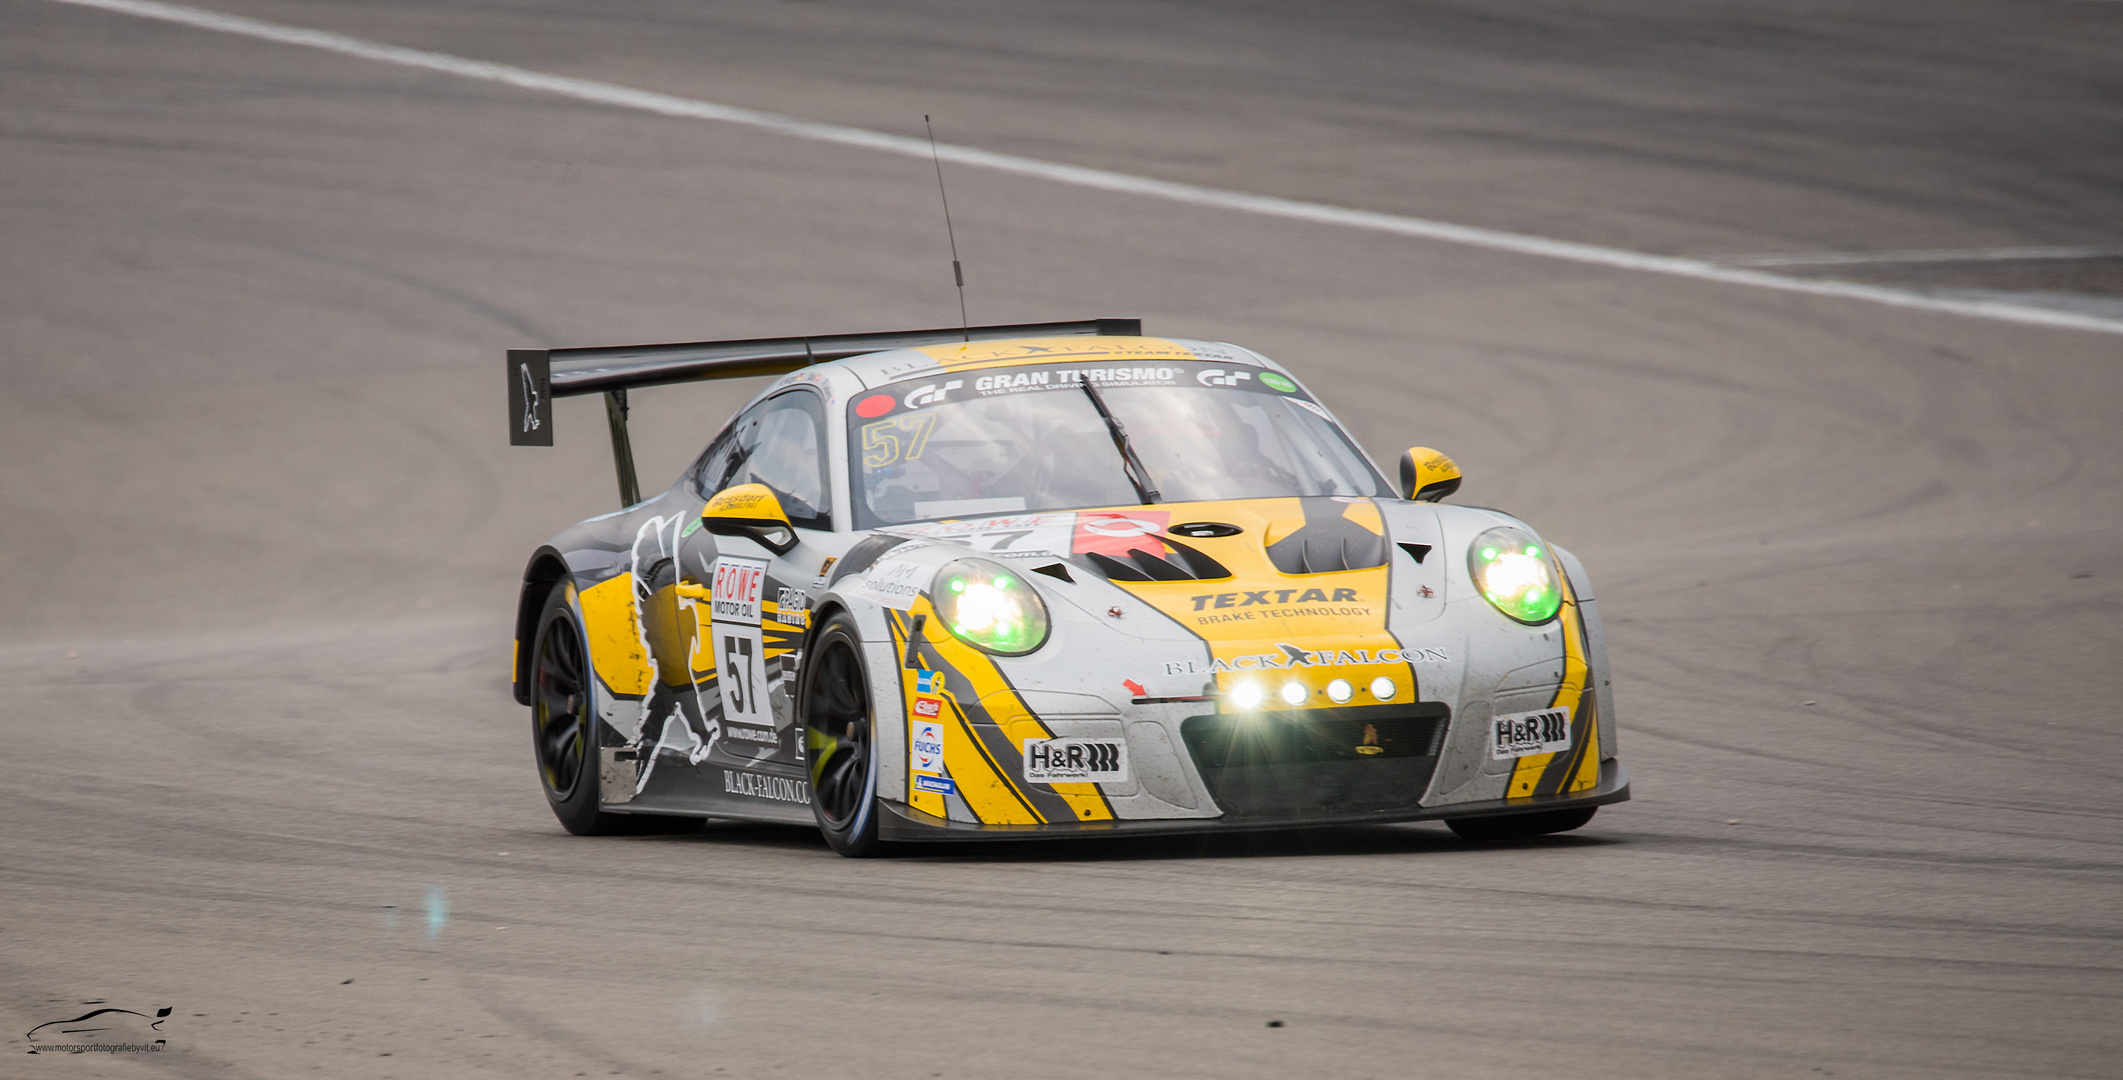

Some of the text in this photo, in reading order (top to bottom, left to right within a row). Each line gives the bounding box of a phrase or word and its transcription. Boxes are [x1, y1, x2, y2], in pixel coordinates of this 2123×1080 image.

[975, 371, 1049, 391] GRAN
[979, 387, 1006, 396] THE
[1009, 384, 1044, 393] REAL
[1099, 379, 1177, 387] SIMULATOR
[862, 412, 936, 468] 57
[714, 566, 760, 602] ROWE
[861, 578, 918, 598] solutions
[714, 600, 754, 618] MOTOR OIL
[1190, 588, 1358, 612] TEXTAR
[1199, 606, 1371, 625] BRAKE TECHNOLOGY
[1165, 647, 1449, 676] BLACK FALCON
[724, 635, 757, 715] 57
[1496, 717, 1541, 746] H&R
[914, 740, 941, 755] FUCHS
[1030, 745, 1085, 770] H&R
